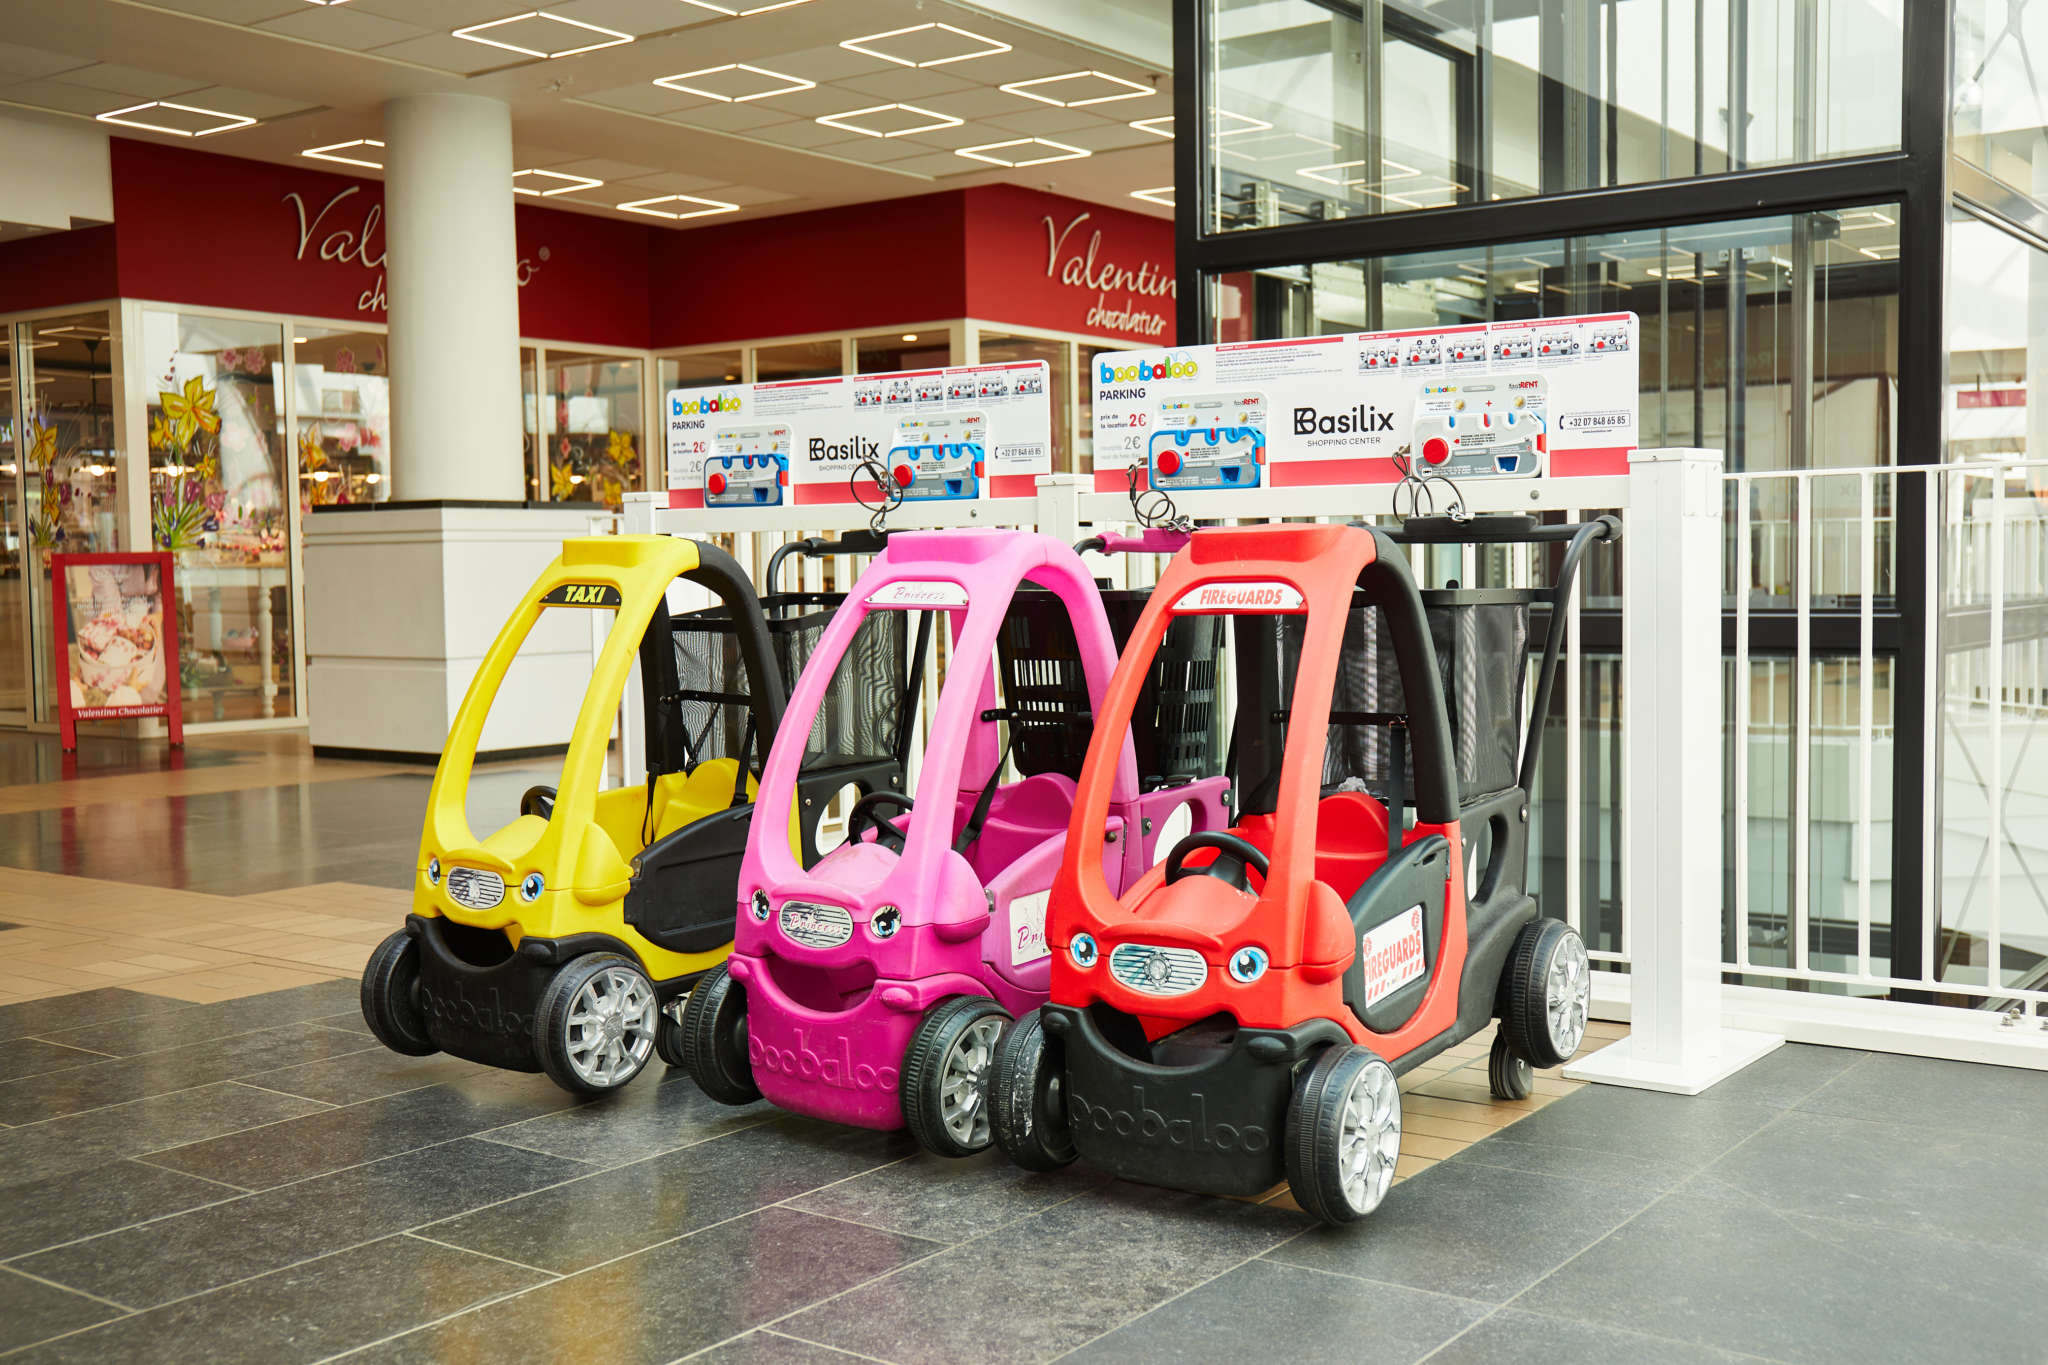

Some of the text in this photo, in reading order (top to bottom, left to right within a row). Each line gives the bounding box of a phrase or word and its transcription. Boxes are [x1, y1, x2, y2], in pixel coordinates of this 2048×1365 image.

[1042, 213, 1176, 299] Valentin
[1086, 292, 1166, 336] chocolatier
[1100, 356, 1198, 384] boobaloo
[1100, 387, 1146, 400] PARKING
[673, 393, 742, 416] boobaloo
[672, 420, 705, 430] PARKING
[1129, 413, 1146, 427] 2€
[1294, 404, 1394, 436] Basilix
[1569, 418, 1581, 427] +32
[1583, 417, 1591, 426] 07
[693, 441, 706, 453] 2€
[809, 435, 879, 461] Basilix
[1124, 435, 1141, 450] 2€
[1307, 436, 1381, 447] SHOPPING CENTER
[564, 585, 606, 603] TAXI
[893, 586, 945, 600] Princess
[1200, 588, 1283, 605] FIREGUARDS
[78, 705, 164, 719] Valentino Chocolatier
[788, 912, 843, 935] Princess
[1363, 930, 1421, 983] FIREGUARDS
